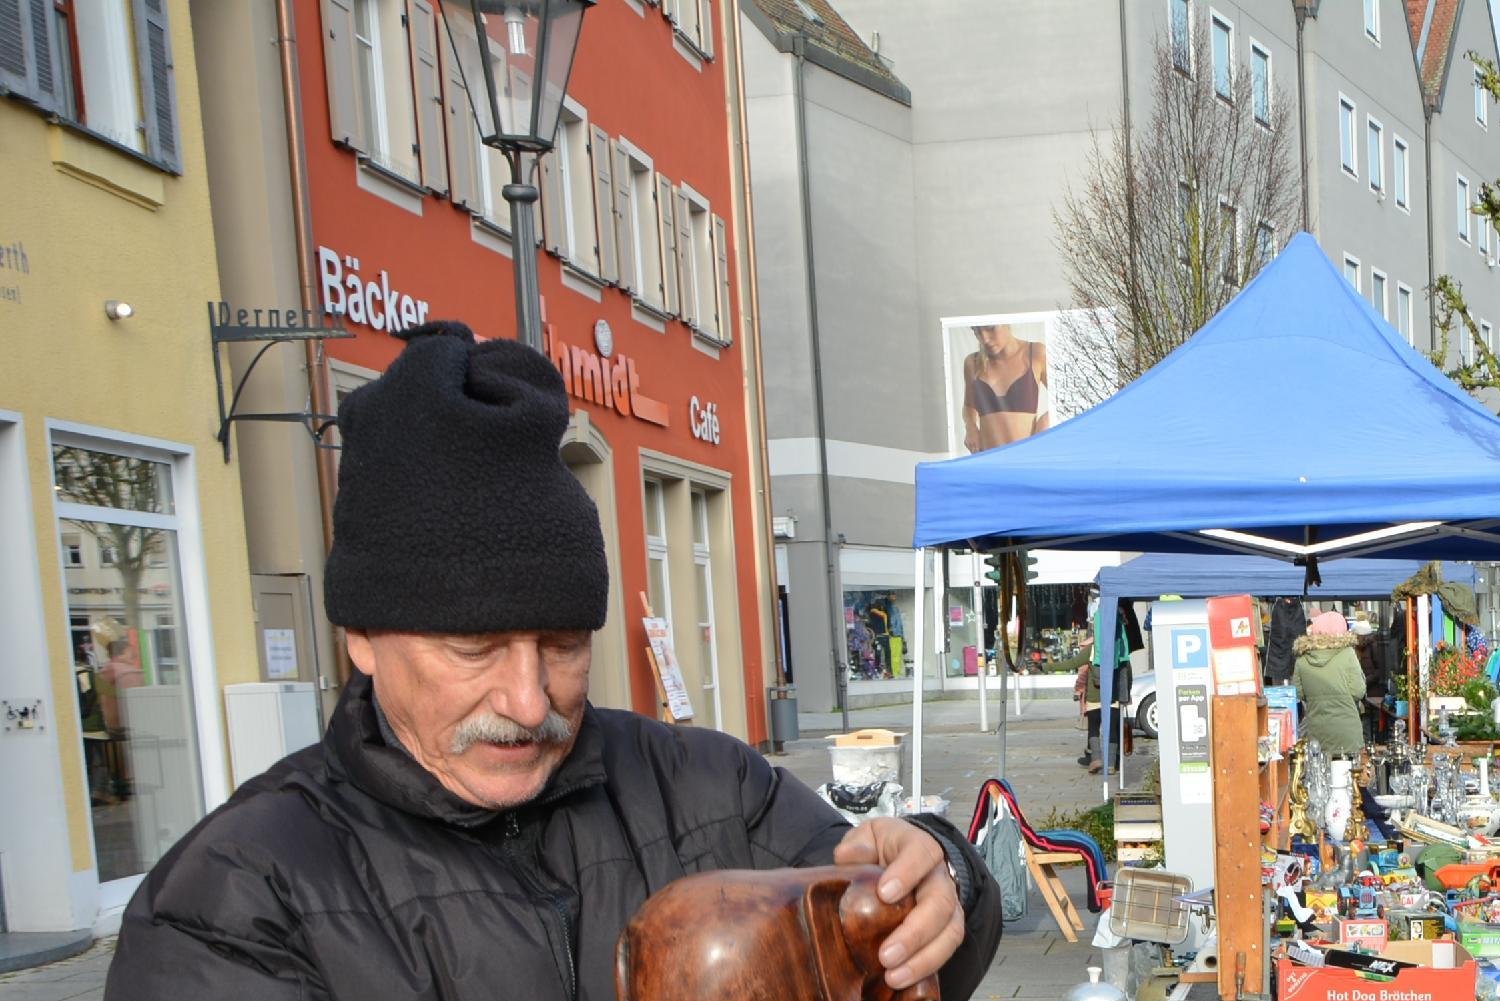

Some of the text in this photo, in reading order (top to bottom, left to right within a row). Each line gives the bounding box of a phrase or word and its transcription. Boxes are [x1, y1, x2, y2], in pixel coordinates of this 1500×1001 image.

[319, 246, 429, 332] Bäcker
[544, 323, 670, 427] hmidt
[690, 395, 720, 445] Café
[1176, 634, 1202, 663] P
[1327, 990, 1348, 1001] Hot
[1380, 990, 1432, 1001] Brötchen
